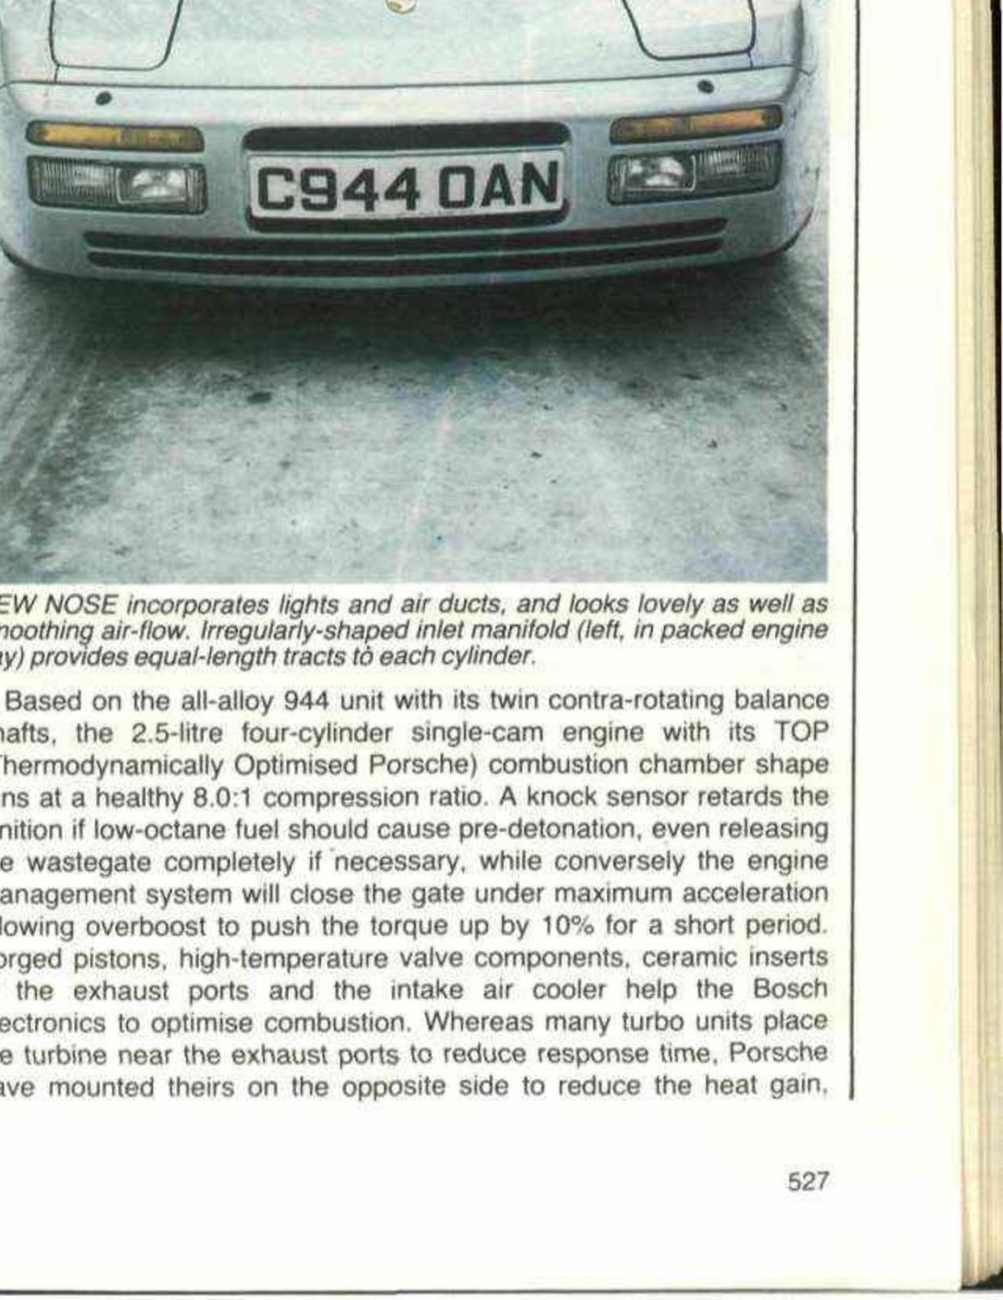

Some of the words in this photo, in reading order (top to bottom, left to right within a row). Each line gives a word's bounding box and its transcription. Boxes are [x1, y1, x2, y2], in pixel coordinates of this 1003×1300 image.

[257, 167, 421, 212] C944
[439, 161, 558, 208] OAN
[45, 594, 120, 616] NOSE
[127, 595, 270, 620] incorporates
[279, 594, 340, 621] lights
[348, 595, 394, 615] and
[401, 594, 432, 614] air
[439, 593, 506, 616] ducts,
[516, 593, 562, 615] and
[569, 593, 630, 615] looks
[638, 594, 705, 620] lovely
[712, 598, 741, 615] as
[750, 593, 796, 614] well
[802, 597, 829, 615] as
[101, 620, 190, 642] air-flow.
[201, 619, 411, 646] Irregularly-shaped
[416, 619, 465, 640] inlet
[471, 618, 571, 640] manifold
[577, 619, 625, 643] (left,
[634, 618, 655, 640] in
[660, 618, 746, 644] packed
[752, 618, 830, 645] engine
[30, 646, 130, 672] provides
[134, 646, 278, 673] equal-length
[284, 648, 347, 667] tracts
[353, 645, 374, 667] to
[379, 645, 437, 667] each
[442, 645, 536, 671] cylinder.
[5, 690, 82, 712] Based
[93, 695, 122, 712] on
[133, 690, 171, 712] the
[182, 690, 275, 717] all-alloy
[285, 690, 330, 712] 944
[341, 690, 384, 712] unit
[395, 689, 443, 711] with
[454, 690, 481, 711] its
[490, 689, 539, 711] twin
[549, 689, 725, 716] contra-rotating
[735, 689, 830, 711] balance
[235, 753, 358, 781] Optimised
[370, 753, 478, 779] Porsche)
[489, 753, 629, 775] combustion
[639, 753, 746, 775] chamber
[756, 753, 830, 779] shape
[74, 948, 167, 974] pistons,
[180, 948, 389, 975] high-temperature
[400, 946, 464, 969] valve
[475, 948, 630, 973] components,
[643, 947, 738, 968] ceramic
[750, 946, 829, 968] inserts
[118, 1014, 141, 1034] to
[151, 1012, 254, 1039] optimise
[265, 1012, 411, 1034] combustion.
[425, 1010, 534, 1033] Whereas
[546, 1015, 612, 1038] many
[622, 1011, 685, 1032] turbo
[696, 1011, 753, 1032] units
[764, 1010, 829, 1036] place
[788, 1170, 831, 1193] 527
